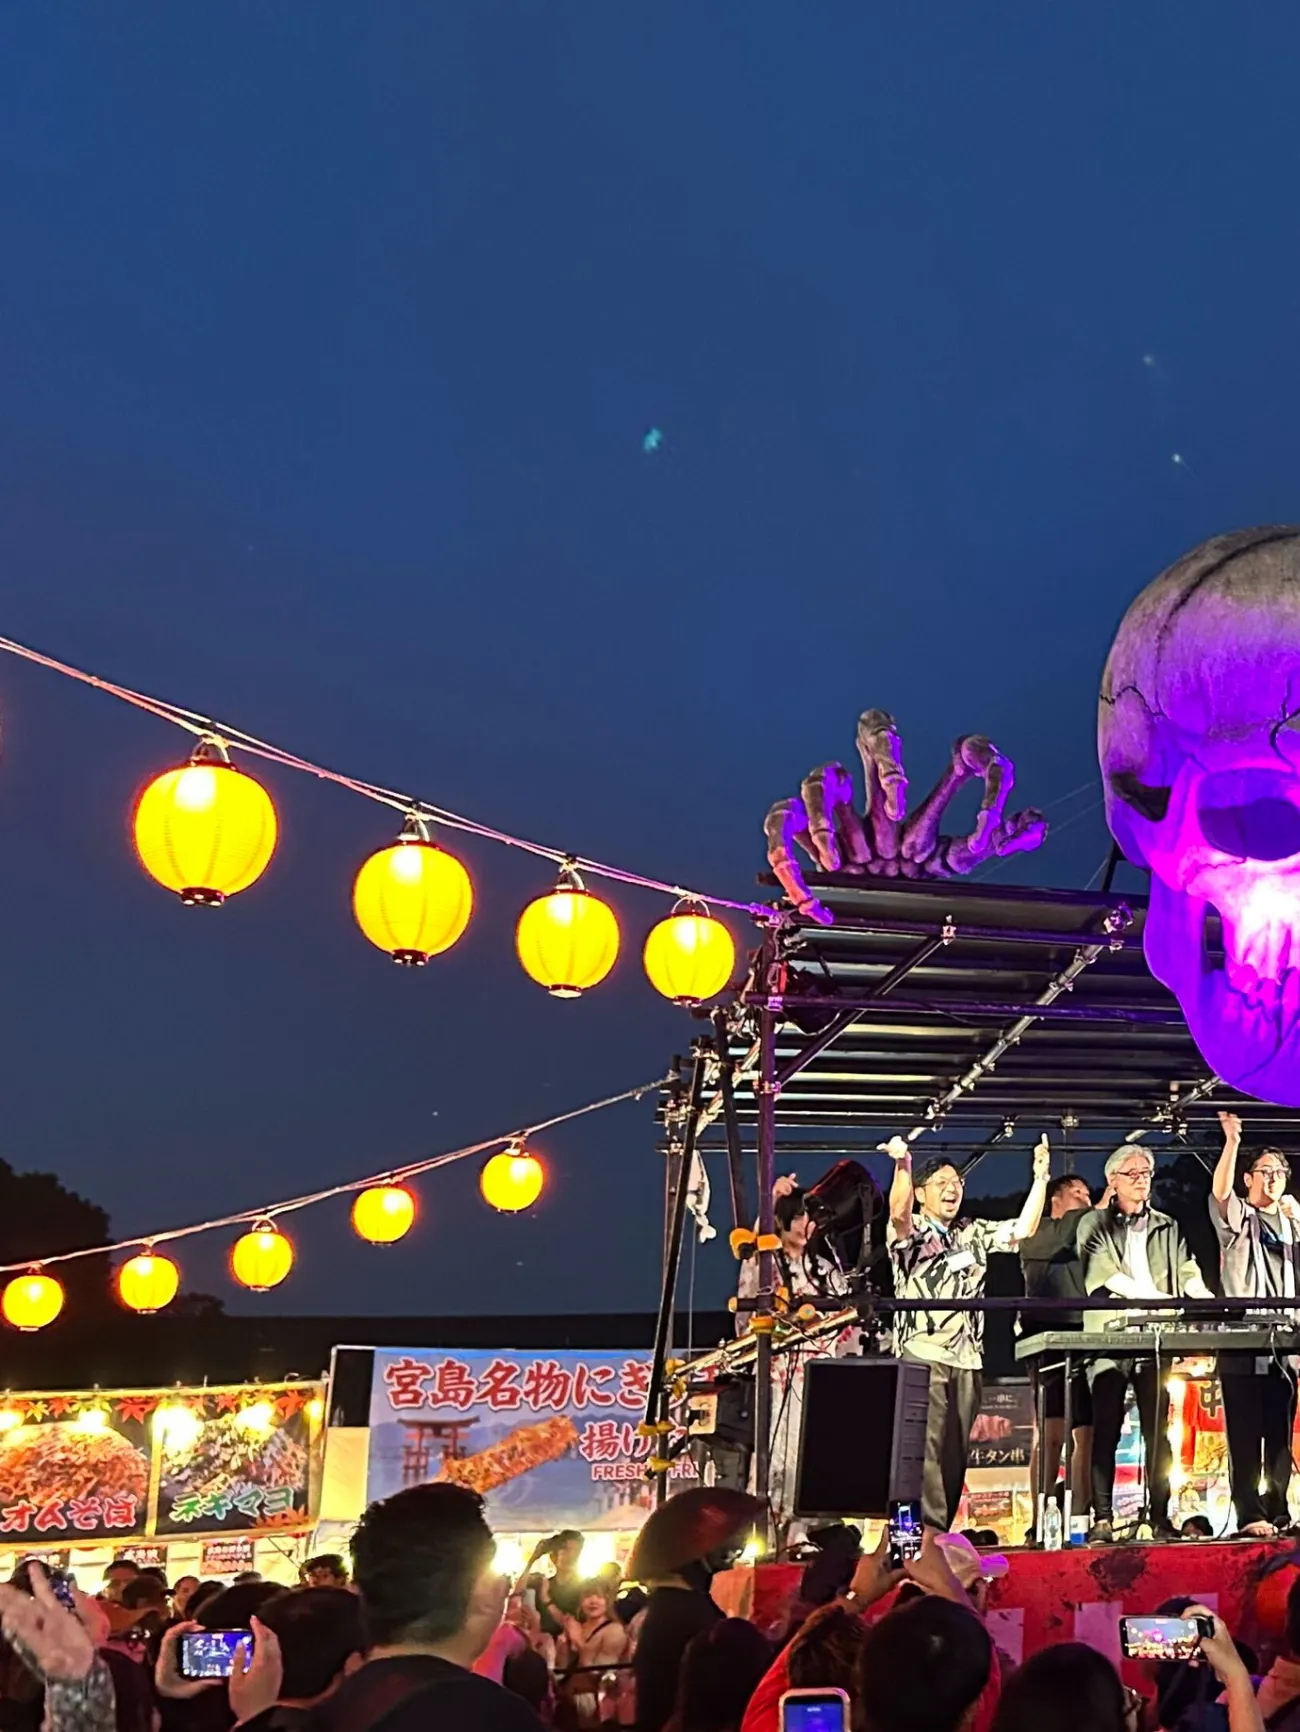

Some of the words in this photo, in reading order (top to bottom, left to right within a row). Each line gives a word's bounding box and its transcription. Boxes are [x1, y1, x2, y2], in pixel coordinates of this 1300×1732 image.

[384, 1358, 718, 1412] 宮島名物にぎ
[0, 1493, 138, 1532] オムそば
